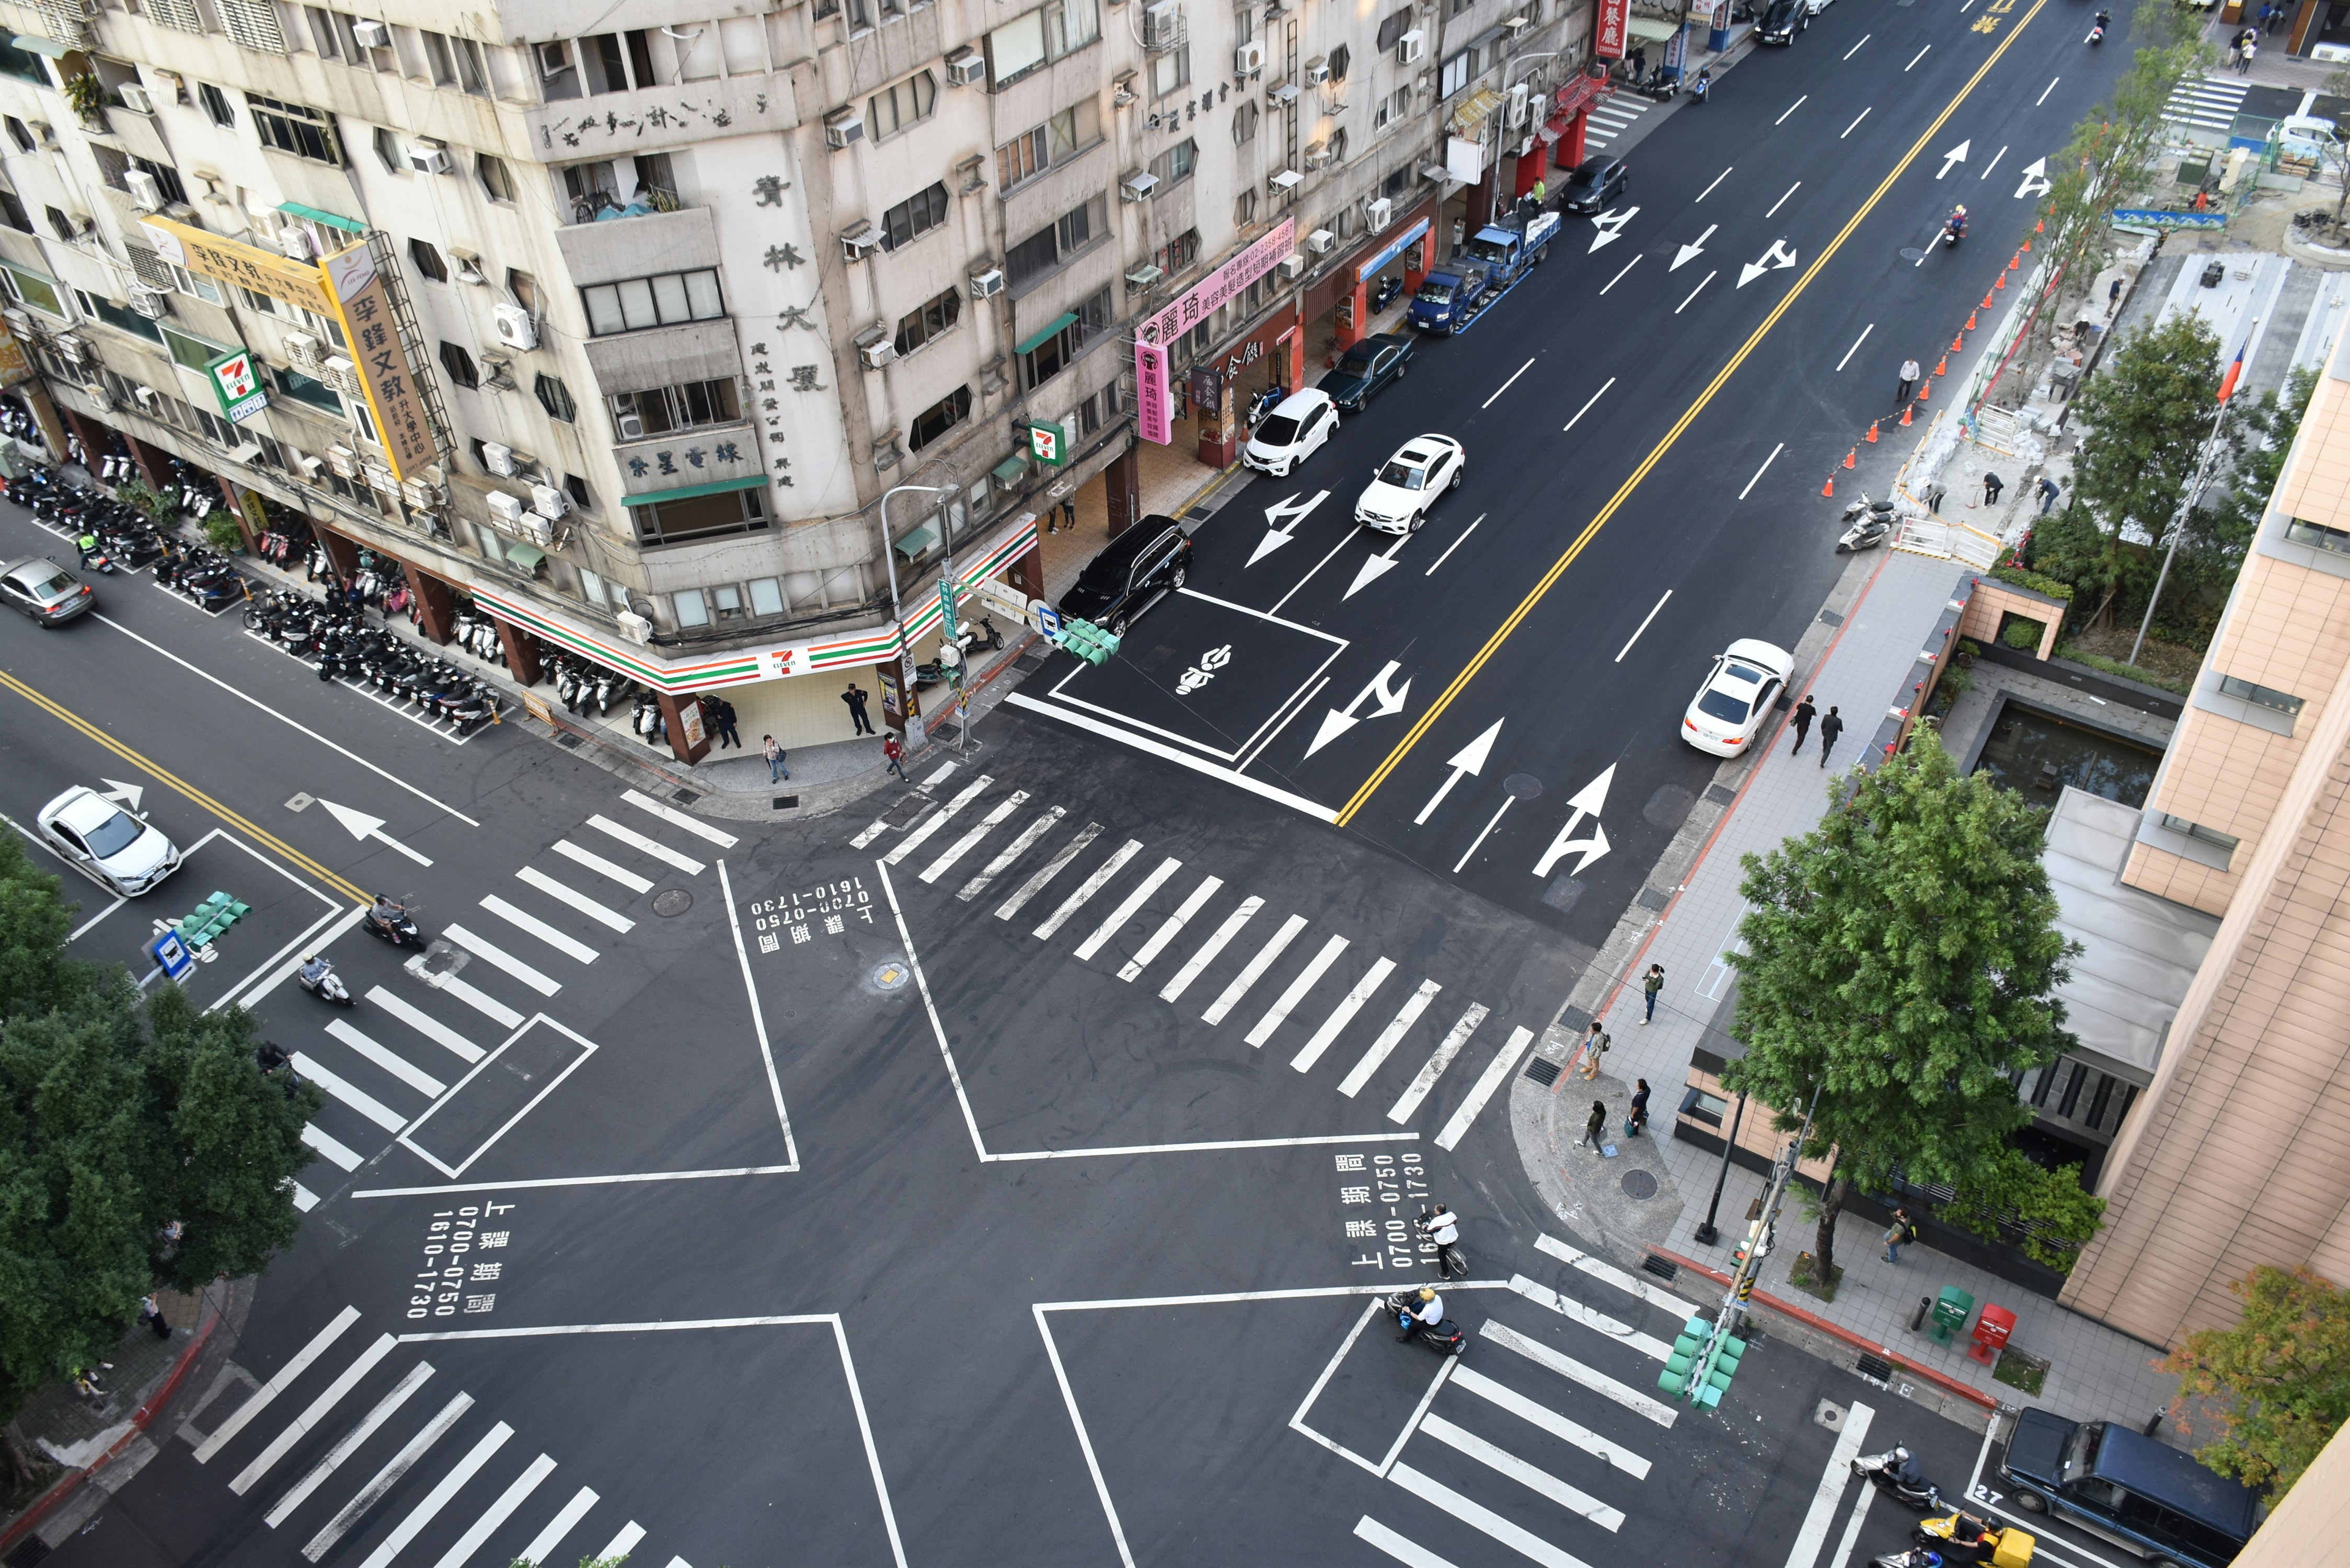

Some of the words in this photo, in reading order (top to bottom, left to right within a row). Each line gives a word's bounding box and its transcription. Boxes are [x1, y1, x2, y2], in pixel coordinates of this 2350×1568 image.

[1602, 0, 1621, 46] 餐廳
[348, 270, 370, 285] LEE-FENG
[1202, 237, 1293, 315] 美容美髮造型短期補習班
[1161, 292, 1199, 343] 麗琦
[226, 373, 250, 390] ELEVEN
[1145, 371, 1157, 401] 麗琦
[398, 399, 425, 454] 升大學中心
[1036, 443, 1053, 452] ELEVEN
[751, 877, 862, 915] 1610-1730
[756, 891, 869, 930] 0700-0750
[758, 905, 873, 953] 上課期間
[1335, 1154, 1384, 1270] 上課期間
[1374, 1155, 1413, 1267] 0700-0750
[1401, 1153, 1440, 1264] 161-1730
[407, 1210, 454, 1318] 1610-1730
[435, 1206, 479, 1316] 0700-0750
[464, 1201, 516, 1313] 上課期間
[1974, 1484, 2004, 1504] 27
